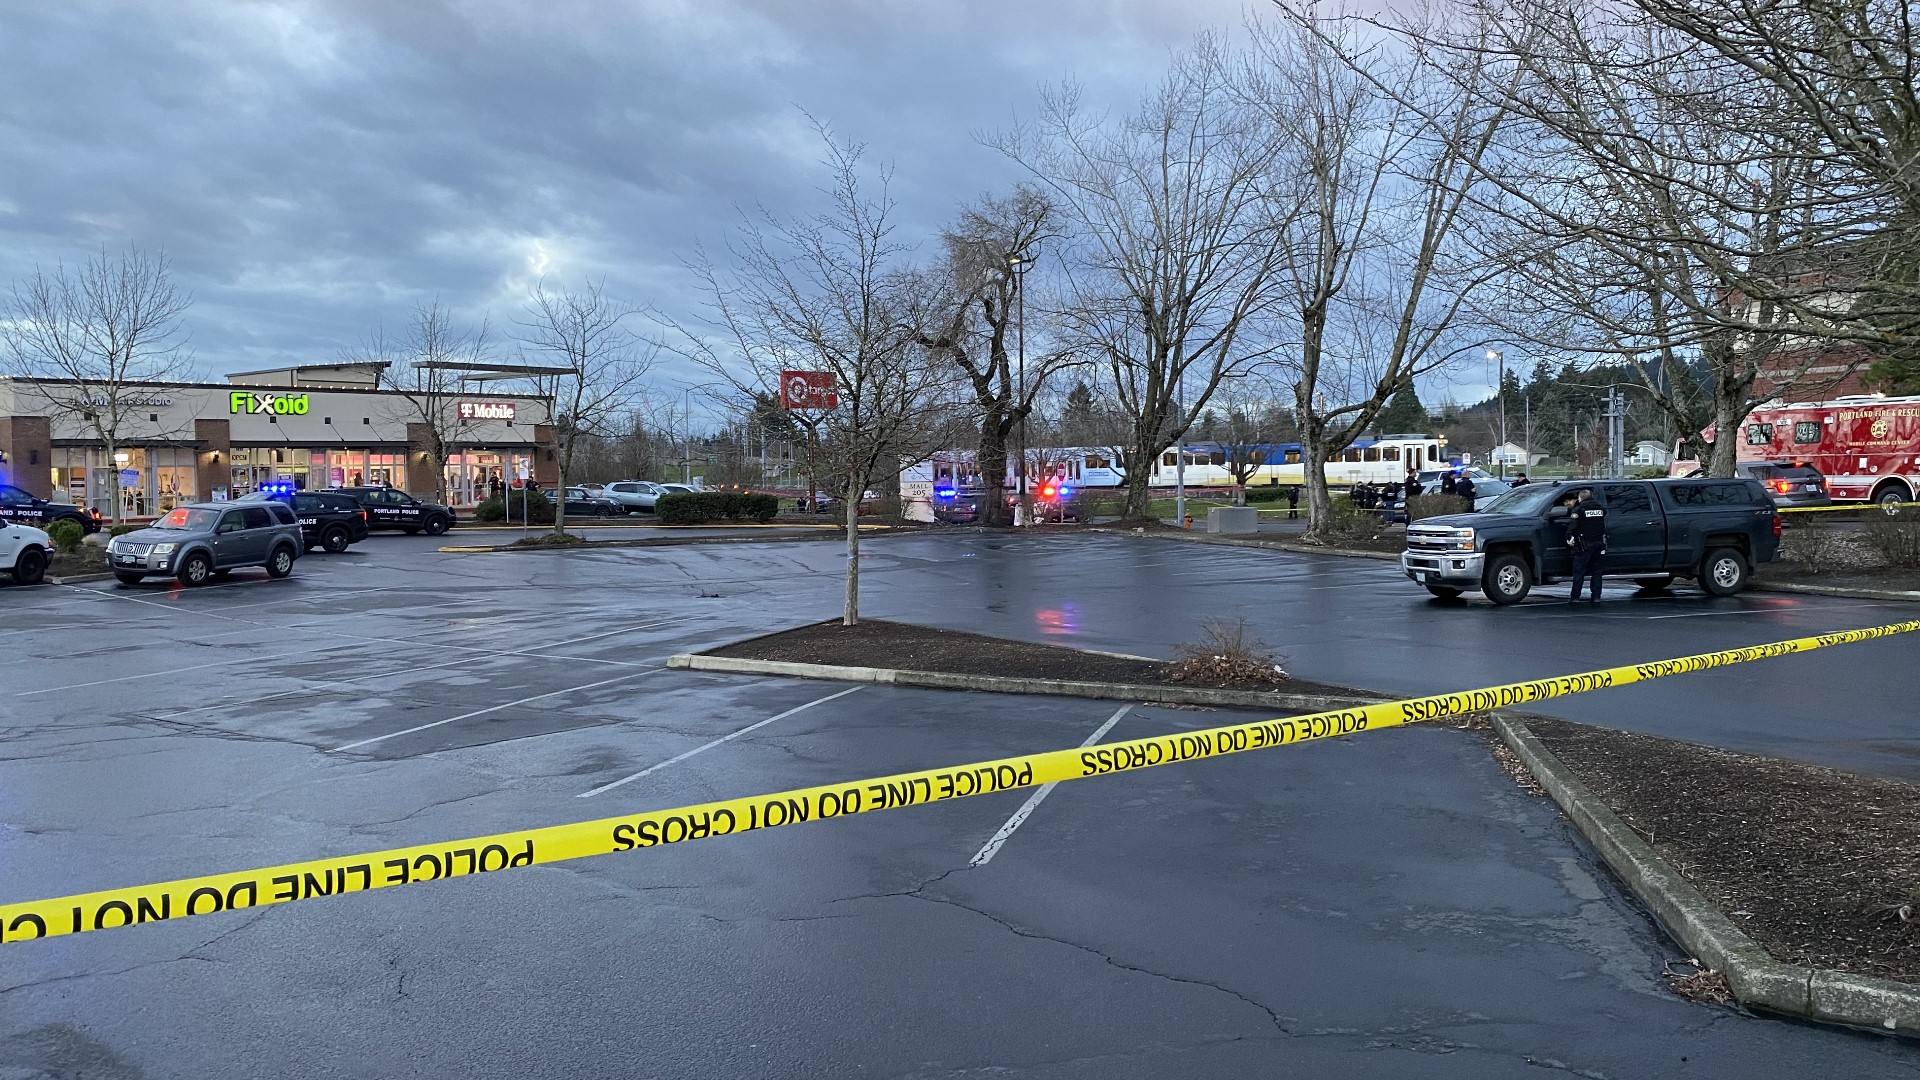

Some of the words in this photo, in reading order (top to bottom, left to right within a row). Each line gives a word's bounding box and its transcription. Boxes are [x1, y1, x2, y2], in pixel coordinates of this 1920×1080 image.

[474, 404, 514, 418] Mobile
[1840, 411, 1873, 421] PORTLAND
[1875, 410, 1890, 418] FIRE
[1898, 408, 1920, 417] RESCU
[1501, 688, 1524, 706] DO
[1527, 681, 1559, 702] LINE
[1562, 672, 1612, 695] POLICE
[1402, 697, 1462, 722] CROSS
[1465, 690, 1498, 712] NOT
[1250, 724, 1295, 748] LINE
[1300, 710, 1368, 738] POLICE
[1166, 735, 1211, 763] NOT
[1217, 731, 1247, 753] DO
[1081, 742, 1163, 775] CROSS
[868, 777, 931, 809] LINE
[937, 762, 1033, 797] POLICE
[746, 797, 810, 830] NOT
[818, 788, 861, 819] DO
[612, 809, 736, 852] CROSS
[385, 840, 534, 882] POLICE
[273, 865, 371, 899] LINE
[186, 881, 257, 914] DO
[0, 913, 47, 943] C
